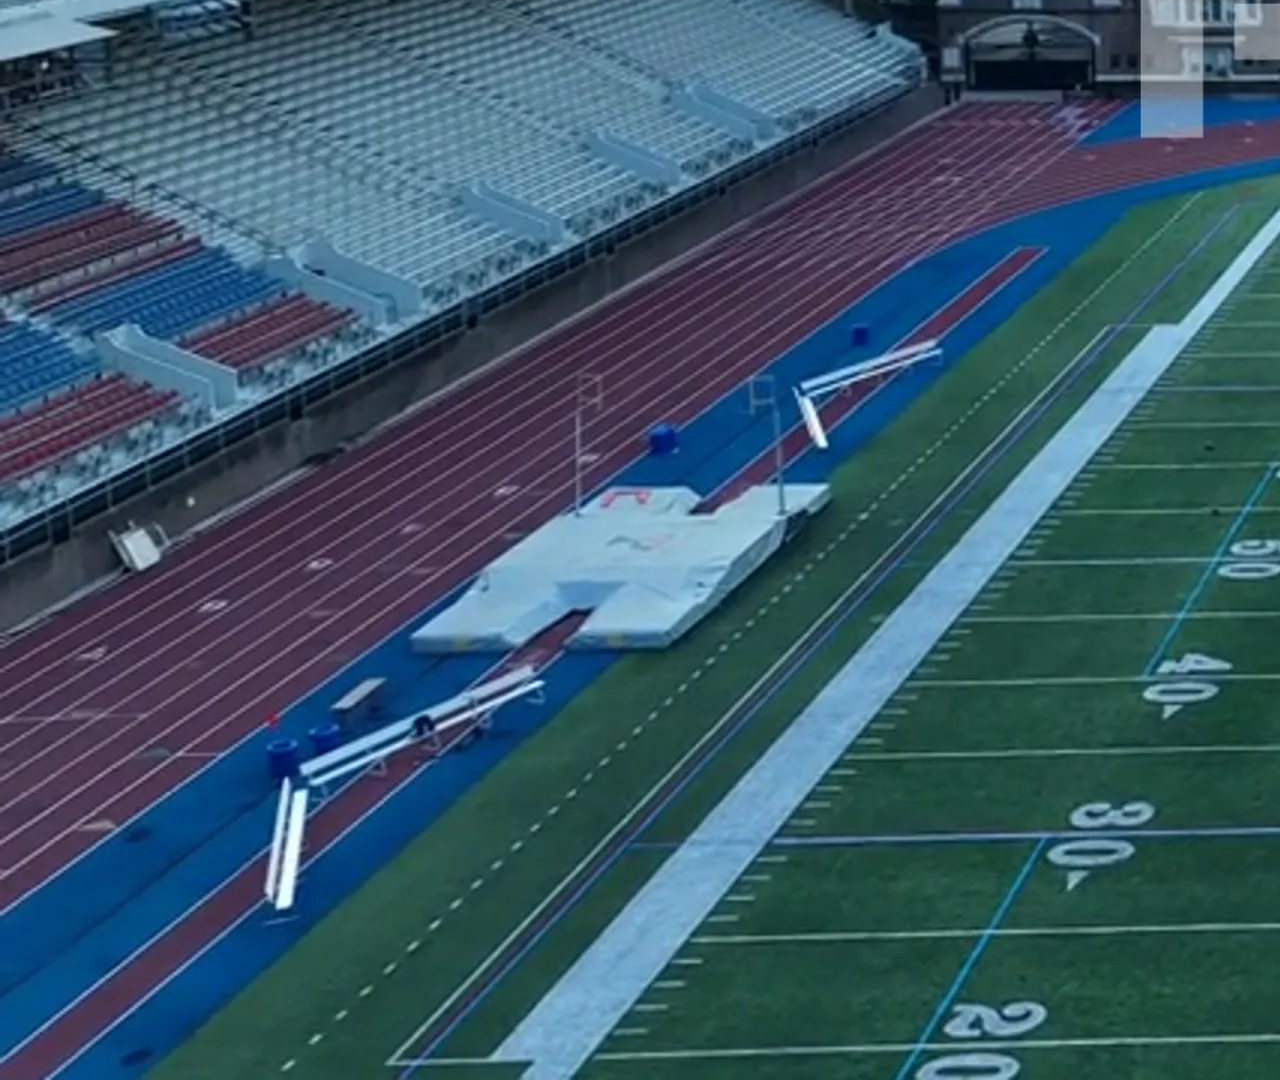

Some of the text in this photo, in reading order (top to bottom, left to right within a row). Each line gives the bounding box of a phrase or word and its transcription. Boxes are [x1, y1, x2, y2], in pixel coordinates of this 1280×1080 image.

[1142, 653, 1233, 702] 40
[1046, 801, 1156, 866] 30
[916, 1001, 1048, 1080] 20
